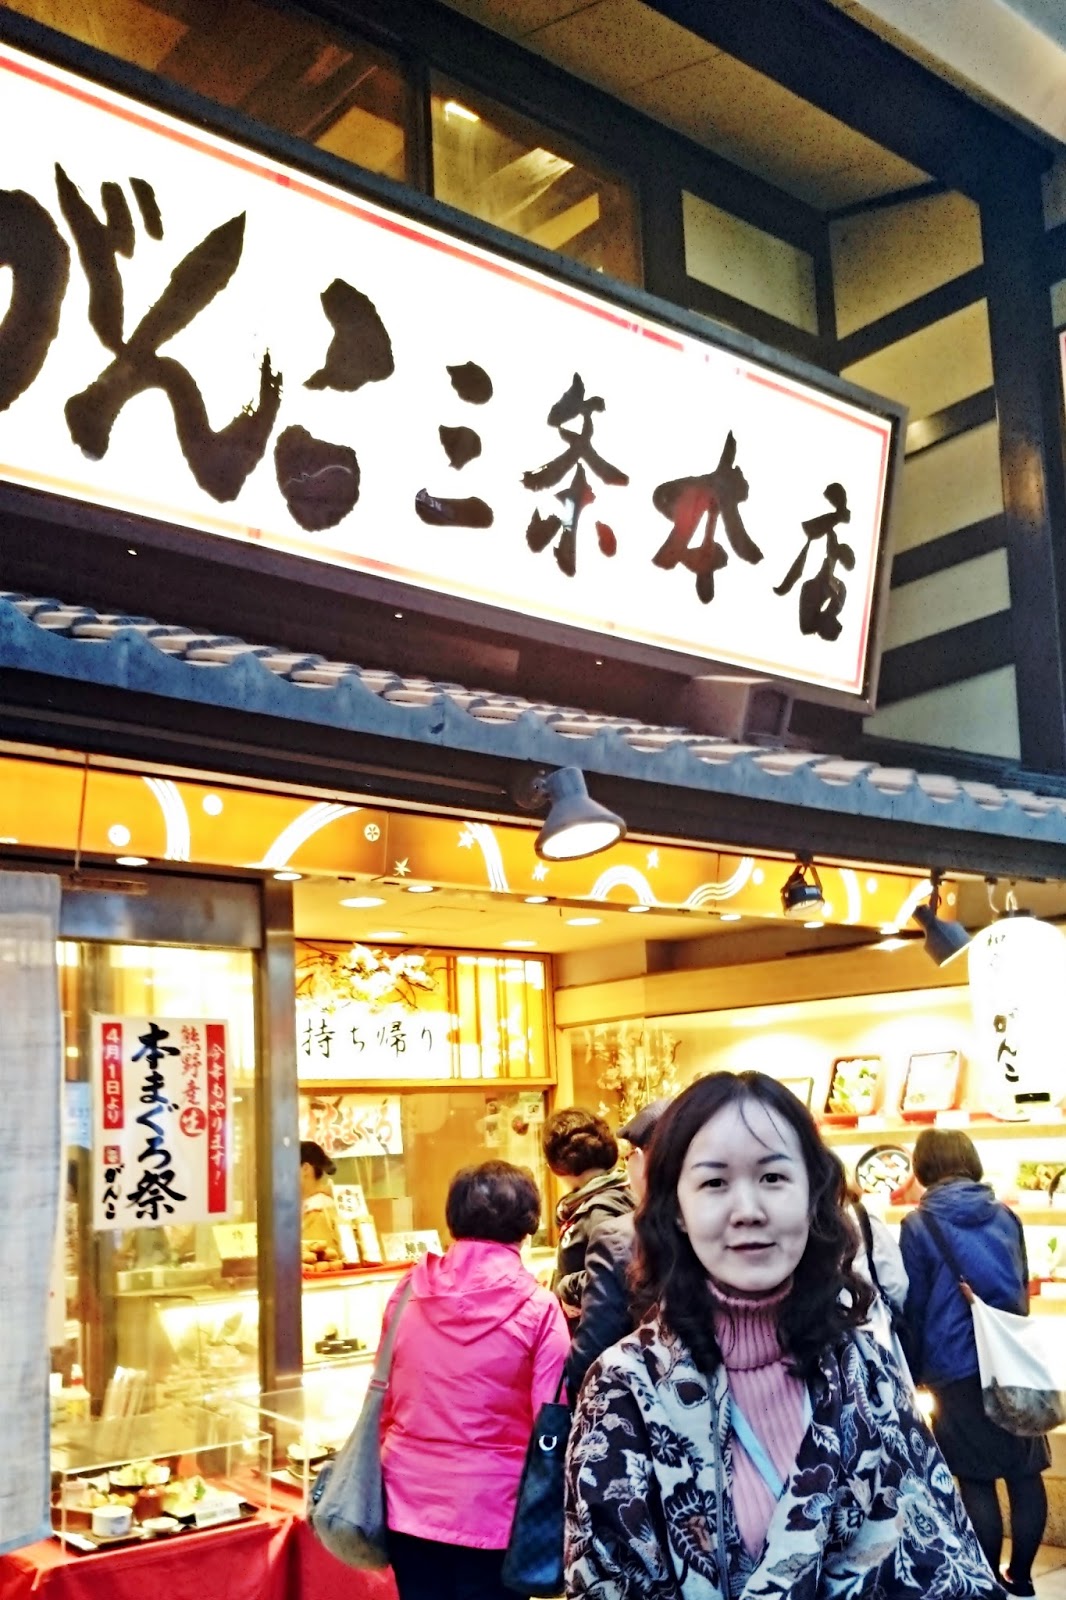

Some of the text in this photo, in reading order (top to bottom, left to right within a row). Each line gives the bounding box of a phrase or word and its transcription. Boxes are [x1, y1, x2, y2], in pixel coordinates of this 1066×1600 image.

[105, 1027, 121, 1124] 4月1日より
[302, 1018, 434, 1059] 持ち帰り
[126, 1022, 187, 1220] 本まぐろ祭
[102, 1164, 125, 1220] がんこ
